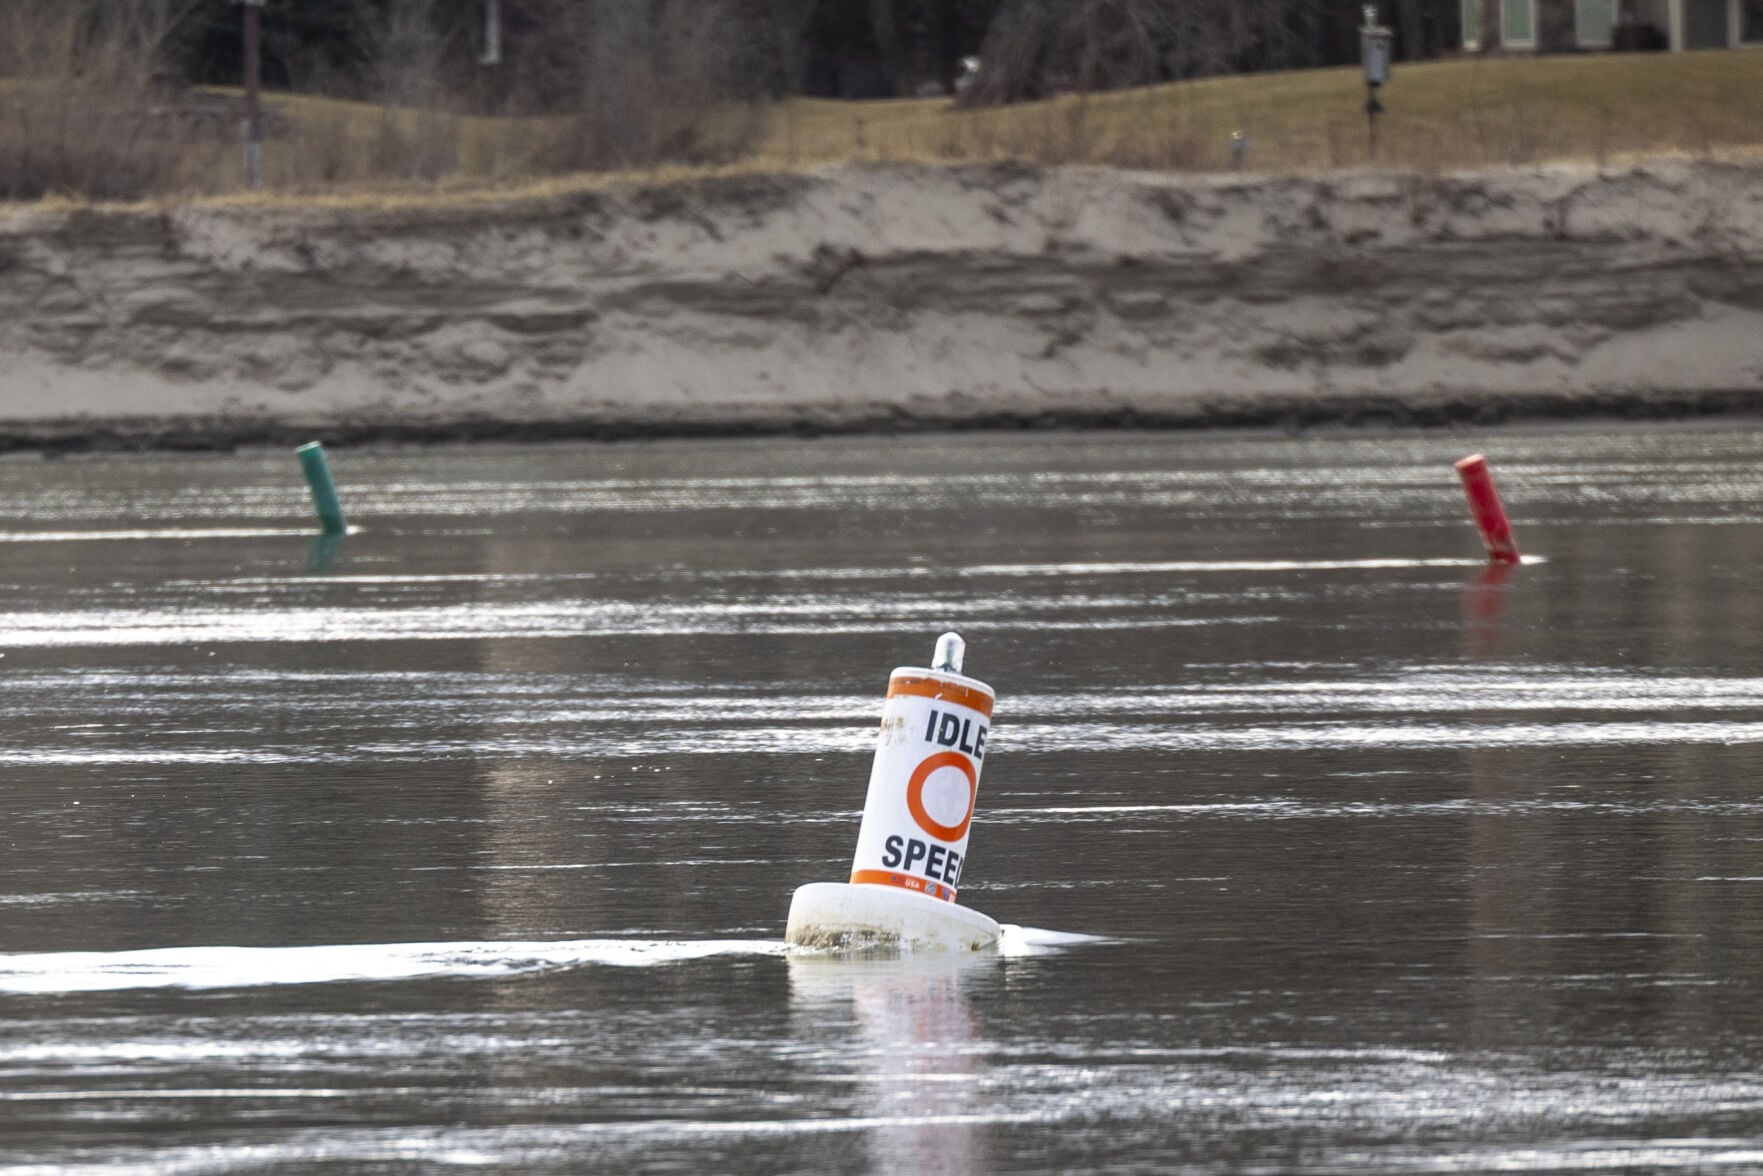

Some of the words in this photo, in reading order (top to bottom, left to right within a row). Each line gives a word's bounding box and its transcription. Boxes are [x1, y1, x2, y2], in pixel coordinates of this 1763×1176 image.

[925, 709, 987, 760] IDLE
[882, 835, 964, 888] SPEE
[905, 878, 920, 888] USA
